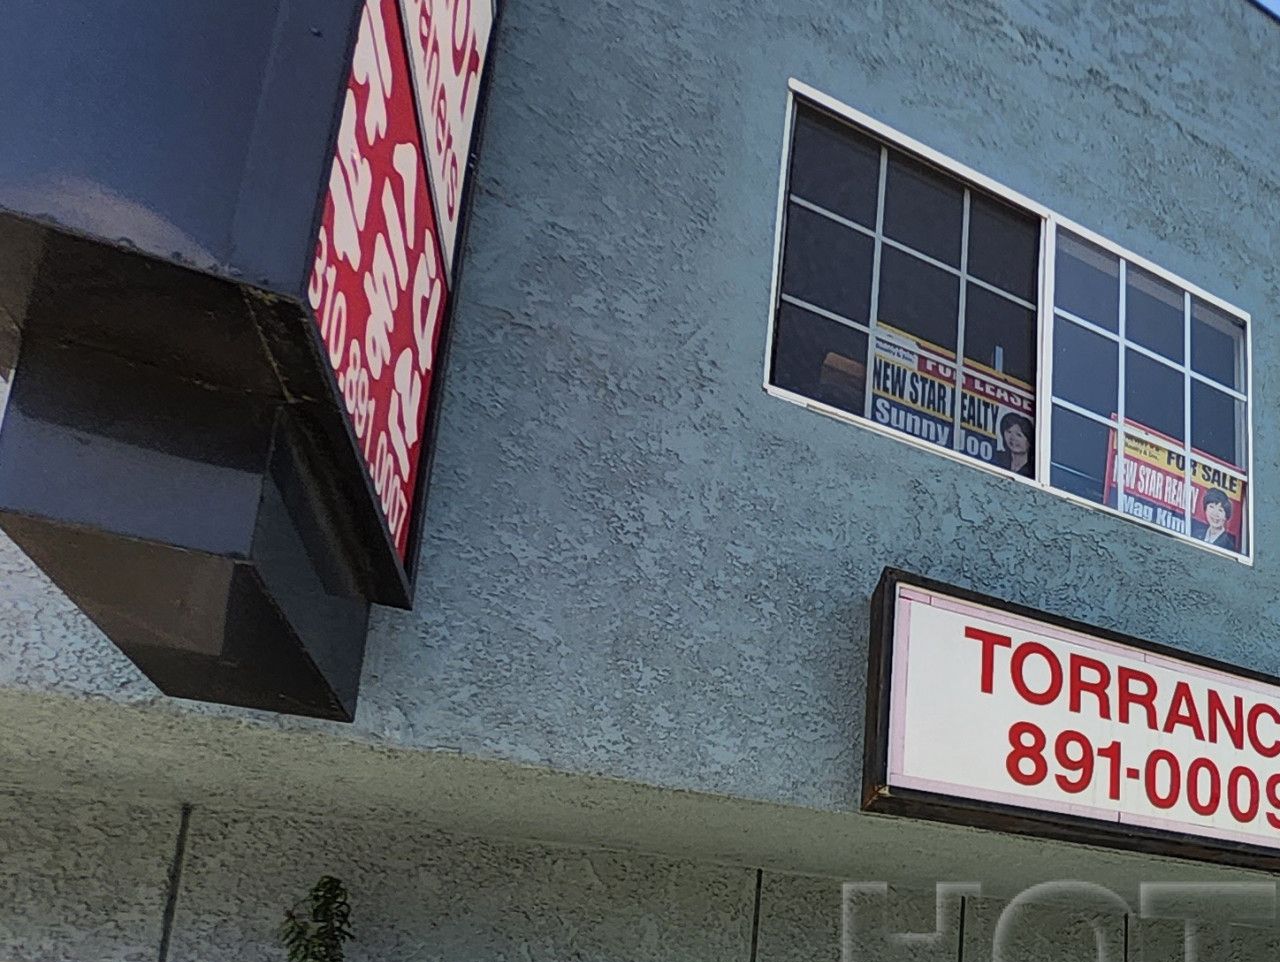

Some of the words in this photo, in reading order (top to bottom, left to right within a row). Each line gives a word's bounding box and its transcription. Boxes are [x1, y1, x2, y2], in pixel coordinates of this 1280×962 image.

[414, 0, 457, 222] aners
[329, 88, 421, 483] 부동산
[308, 225, 408, 549] 310.891.0007
[873, 357, 906, 400] NEW
[909, 371, 947, 417] STAR
[875, 398, 950, 446] Sunny
[1137, 464, 1164, 499] STAR
[1201, 464, 1238, 494] SALE
[1122, 494, 1154, 522] Mag
[1156, 507, 1186, 534] Kim
